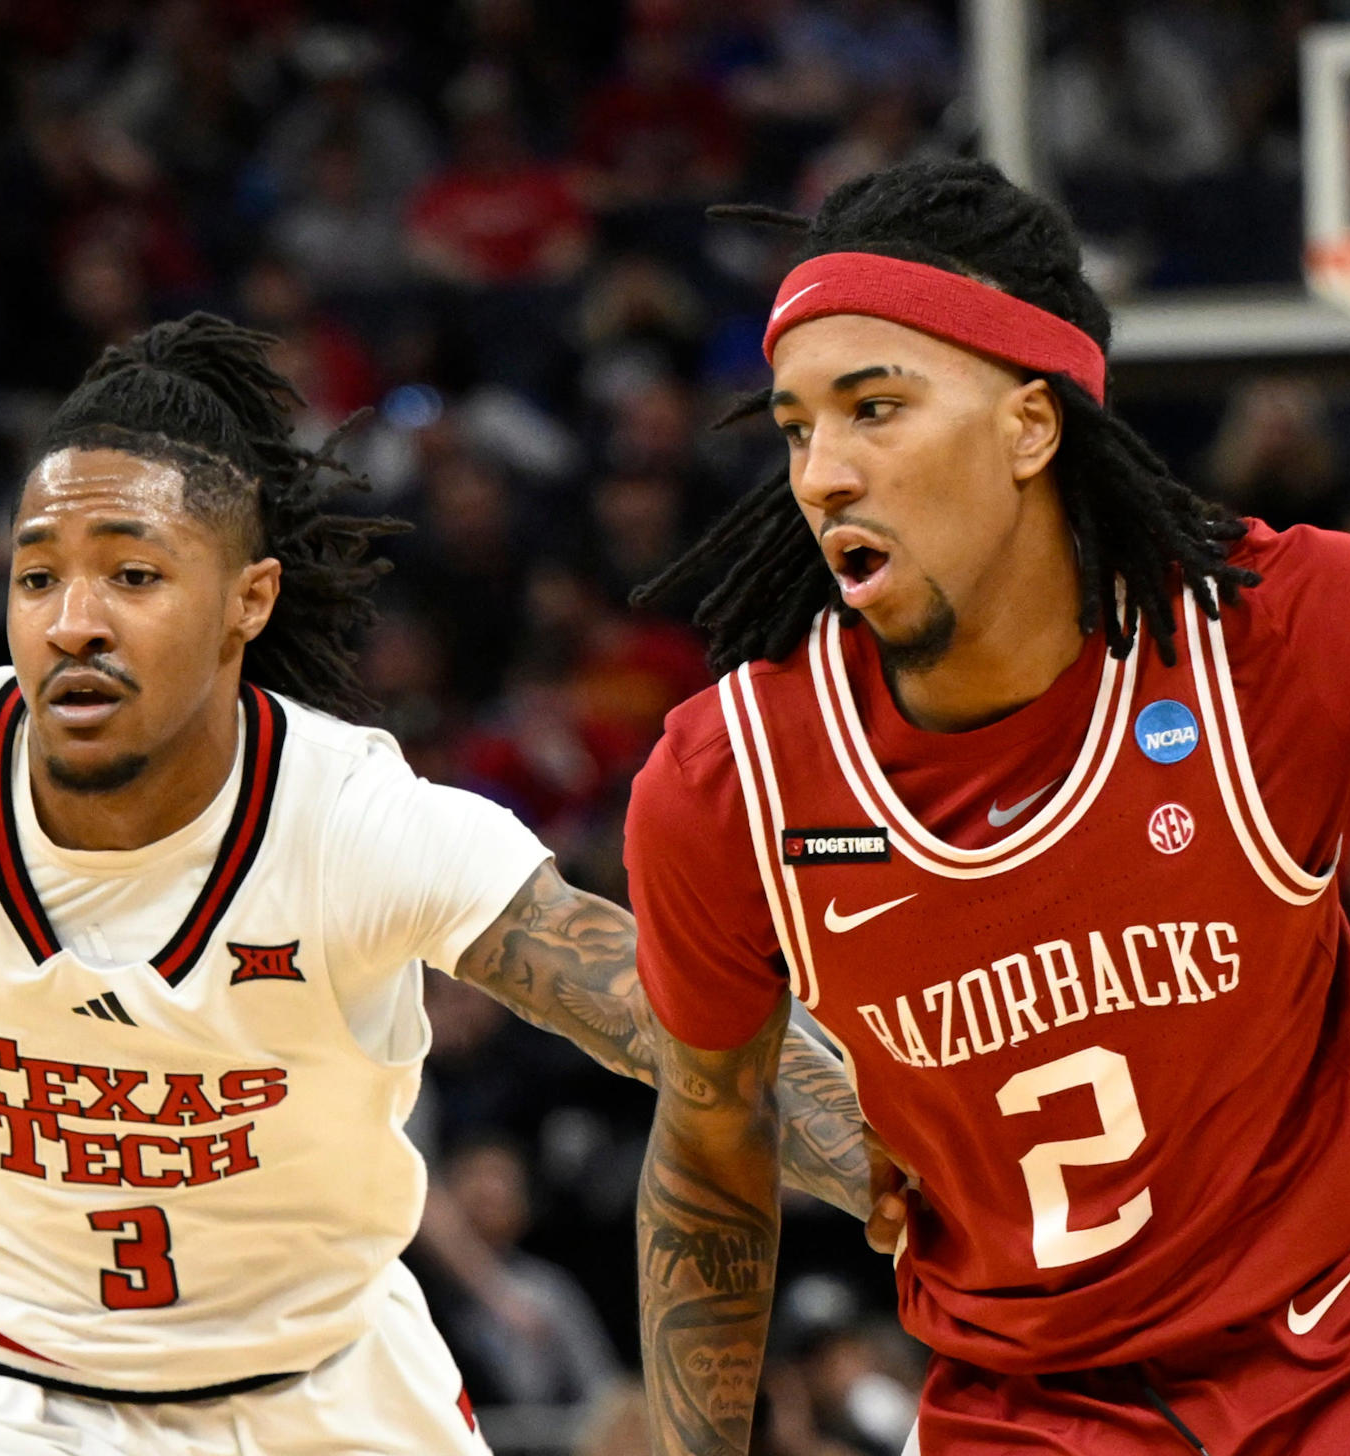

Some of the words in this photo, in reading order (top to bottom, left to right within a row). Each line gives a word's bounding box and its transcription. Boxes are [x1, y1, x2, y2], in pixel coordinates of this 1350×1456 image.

[1145, 726, 1196, 749] NCAA
[805, 836, 886, 855] TOGETHER
[1150, 805, 1193, 853] SEC
[857, 921, 1241, 1068] RAZORBACKS
[995, 1045, 1154, 1270] 2
[86, 1204, 180, 1311] 3
